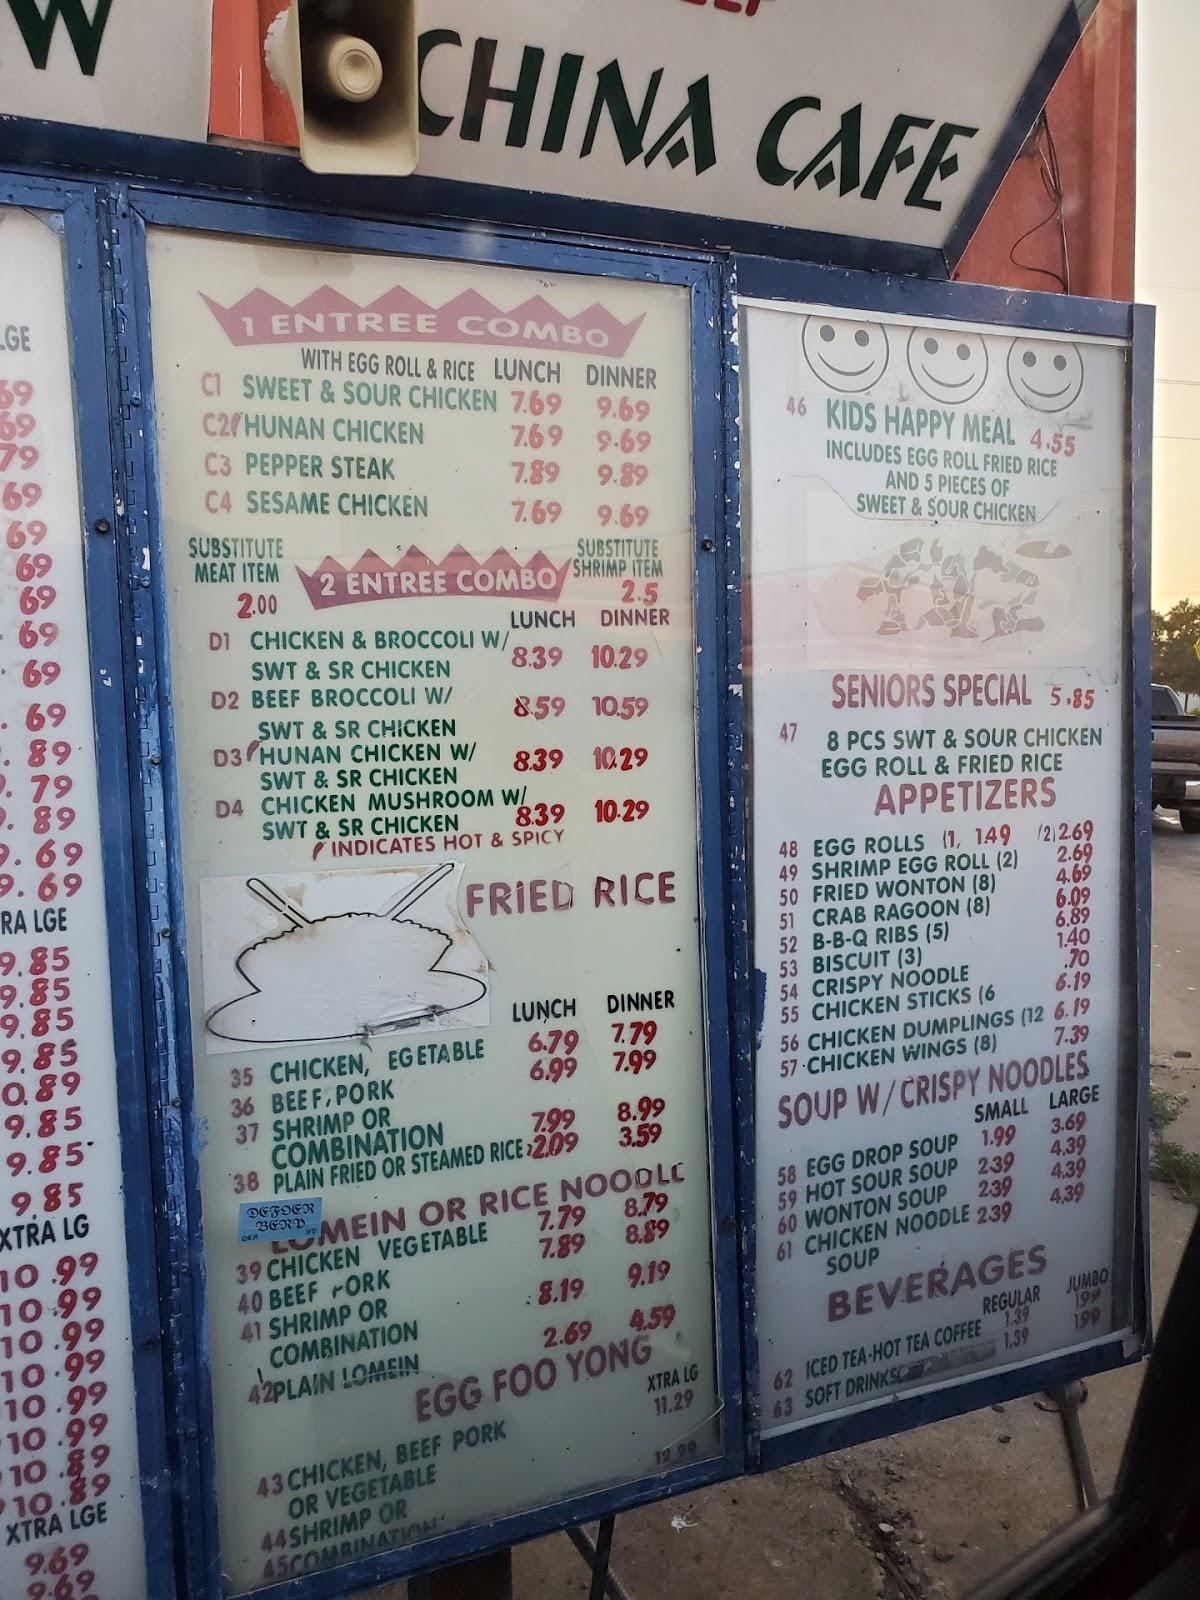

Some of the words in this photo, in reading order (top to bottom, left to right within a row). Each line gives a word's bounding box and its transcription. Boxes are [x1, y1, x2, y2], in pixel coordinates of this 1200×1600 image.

[417, 28, 716, 177] CHINA
[756, 95, 980, 211] CAFE
[241, 317, 254, 336] 1
[271, 312, 439, 335] ENTREE
[457, 315, 609, 348] COMBO
[301, 347, 342, 371] WITH
[348, 352, 380, 375] EGG
[386, 355, 422, 378] ROLL
[427, 358, 437, 378] &
[443, 359, 474, 381] RICE
[494, 358, 560, 384] LUNCH
[587, 364, 657, 389] DINNER
[243, 374, 312, 402] SWEET
[320, 380, 335, 403] &
[344, 381, 401, 407] SOUR
[408, 384, 497, 412] CHICKEN
[511, 390, 562, 416] 7.69
[597, 396, 650, 422] 9.69
[244, 414, 325, 441] HUNAN
[333, 418, 424, 445] CHICKEN
[511, 424, 563, 449] 7.69
[596, 429, 651, 454] 9.69
[826, 398, 876, 433] KIDS
[885, 404, 955, 440] HAPPY
[962, 413, 1015, 446] MEAL
[1030, 428, 1075, 457] 4.55
[246, 452, 323, 478] PEPPER
[331, 455, 395, 480] STEAK
[511, 459, 560, 485] 7.89
[598, 462, 648, 487] 9.89
[826, 440, 901, 465] INCLUDES
[907, 449, 938, 468] EGG
[943, 450, 979, 472] ROLL
[983, 456, 1023, 474] FRIED
[1027, 459, 1057, 477] RICE
[885, 471, 919, 491] AND
[924, 473, 933, 492] 5
[938, 475, 986, 496] PIECES
[991, 479, 1010, 498] OF
[857, 493, 906, 517] SWEET
[911, 498, 922, 517] &
[928, 498, 969, 519] SOUR
[974, 501, 1036, 522] CHICKEN
[188, 537, 283, 559] SUBSTITUTE
[577, 538, 658, 558] SUBSTITUTE
[195, 562, 236, 583] MEAT
[243, 563, 279, 583] ITEM
[320, 573, 336, 596] 2
[347, 571, 447, 595] ENTREE
[456, 568, 557, 592] COMBO
[573, 558, 626, 578] SHRIMP
[633, 560, 663, 578] ITEM
[237, 593, 277, 619] 2.00
[622, 580, 658, 606] 2.5
[511, 611, 576, 629] LUNCH
[601, 609, 670, 627] DINNER
[832, 672, 935, 709] SENIORS
[943, 673, 1032, 707] SPECIAL
[1050, 687, 1095, 710] 5.85
[260, 746, 341, 766] HUNAN
[351, 744, 441, 763] CHICKEN
[450, 742, 476, 762] W/
[514, 748, 563, 771] 8.39
[593, 747, 648, 771] 10.29
[827, 730, 839, 751] 8
[848, 730, 885, 751] PCS
[893, 729, 935, 750] SWT
[943, 729, 956, 748] &
[964, 728, 1017, 748] SOUR
[1024, 726, 1102, 747] CHICKEN
[822, 758, 867, 778] EGG
[876, 756, 927, 777] ROLL
[935, 755, 949, 775] &
[958, 753, 1014, 774] FRIED
[1021, 752, 1063, 773] RICE
[261, 794, 355, 816] CHICKEN
[368, 789, 494, 811] MUSHROOM
[502, 785, 527, 806] W/
[516, 803, 565, 827] 8.39
[595, 799, 649, 823] 10.29
[874, 776, 1056, 816] APPETIZERS
[332, 835, 435, 857] INDICATES
[444, 834, 483, 850] HOT
[491, 833, 503, 848] &
[512, 829, 565, 846] SPICY
[814, 838, 855, 857] EGG
[865, 834, 924, 854] ROLLS
[1059, 820, 1093, 842] 2.69
[466, 880, 574, 918] FRIED
[595, 871, 676, 908] RICE
[813, 906, 866, 926] CRAB
[874, 898, 960, 921] RAGOON
[967, 896, 990, 918] (8)
[1056, 886, 1090, 908] 6.09
[813, 929, 867, 950] B-B-Q
[876, 925, 918, 944] RIBS
[926, 921, 949, 943] (5)
[1056, 907, 1090, 927] 6.89
[813, 950, 890, 974] BISCUIT
[898, 947, 922, 969] (3)
[1057, 927, 1090, 948] 1.40
[512, 998, 576, 1022] LUNCH
[607, 990, 675, 1014] DINNER
[812, 994, 900, 1021] CHICKEN
[907, 987, 971, 1010] STICKS
[528, 1029, 579, 1055] 6.79
[612, 1020, 657, 1046] 7.79
[808, 1024, 896, 1051] CHICKEN
[903, 1009, 1014, 1039] DUMPLINGS
[530, 1057, 577, 1083] 6.99
[613, 1050, 656, 1075] 7.99
[778, 1088, 847, 1129] SOUP
[989, 1050, 1089, 1093] NOODLES
[975, 1097, 1028, 1123] SMALL
[1050, 1085, 1100, 1109] LARGE
[273, 1111, 354, 1142] SHRIMP
[362, 1106, 391, 1130] OR
[272, 1121, 445, 1170] COMBINATION
[807, 1153, 845, 1178] EGG
[852, 1143, 902, 1169] DROP
[909, 1133, 958, 1159] SOUP
[982, 1124, 1016, 1147] 1.99
[1051, 1111, 1086, 1134] 3.69
[273, 1167, 324, 1194] PLAIN
[331, 1160, 377, 1186] FRIED
[382, 1157, 406, 1179] OR
[412, 1144, 485, 1174] STEAMED
[490, 1139, 524, 1162] RICE
[480, 1182, 548, 1217] RICE
[64, 1214, 89, 1241] LG
[267, 1246, 360, 1282] CHICKEN
[378, 1222, 488, 1260] VEGETABLE
[538, 1205, 586, 1231] 7.79
[624, 1192, 668, 1218] 8.79
[828, 1245, 1047, 1322] BEVERAGES
[983, 1285, 1041, 1315] REGULAR
[1066, 1268, 1109, 1294] JUMBO
[806, 1355, 838, 1380] ICED
[906, 1333, 930, 1351] TEA
[934, 1319, 982, 1347] COFFEE
[416, 1376, 482, 1423] EGG
[493, 1358, 557, 1402] FOO
[566, 1334, 652, 1382] YONG
[648, 1368, 680, 1392] XTRA
[684, 1363, 699, 1384] LG
[805, 1383, 840, 1409] SOFT
[845, 1370, 899, 1398] DRINKS
[654, 1389, 694, 1416] 11.29
[396, 1435, 441, 1465] BEEF
[453, 1420, 506, 1451] PORK
[6, 1513, 63, 1546] XTRA
[70, 1501, 107, 1530] LGE
[25, 1543, 89, 1576] 9.69
